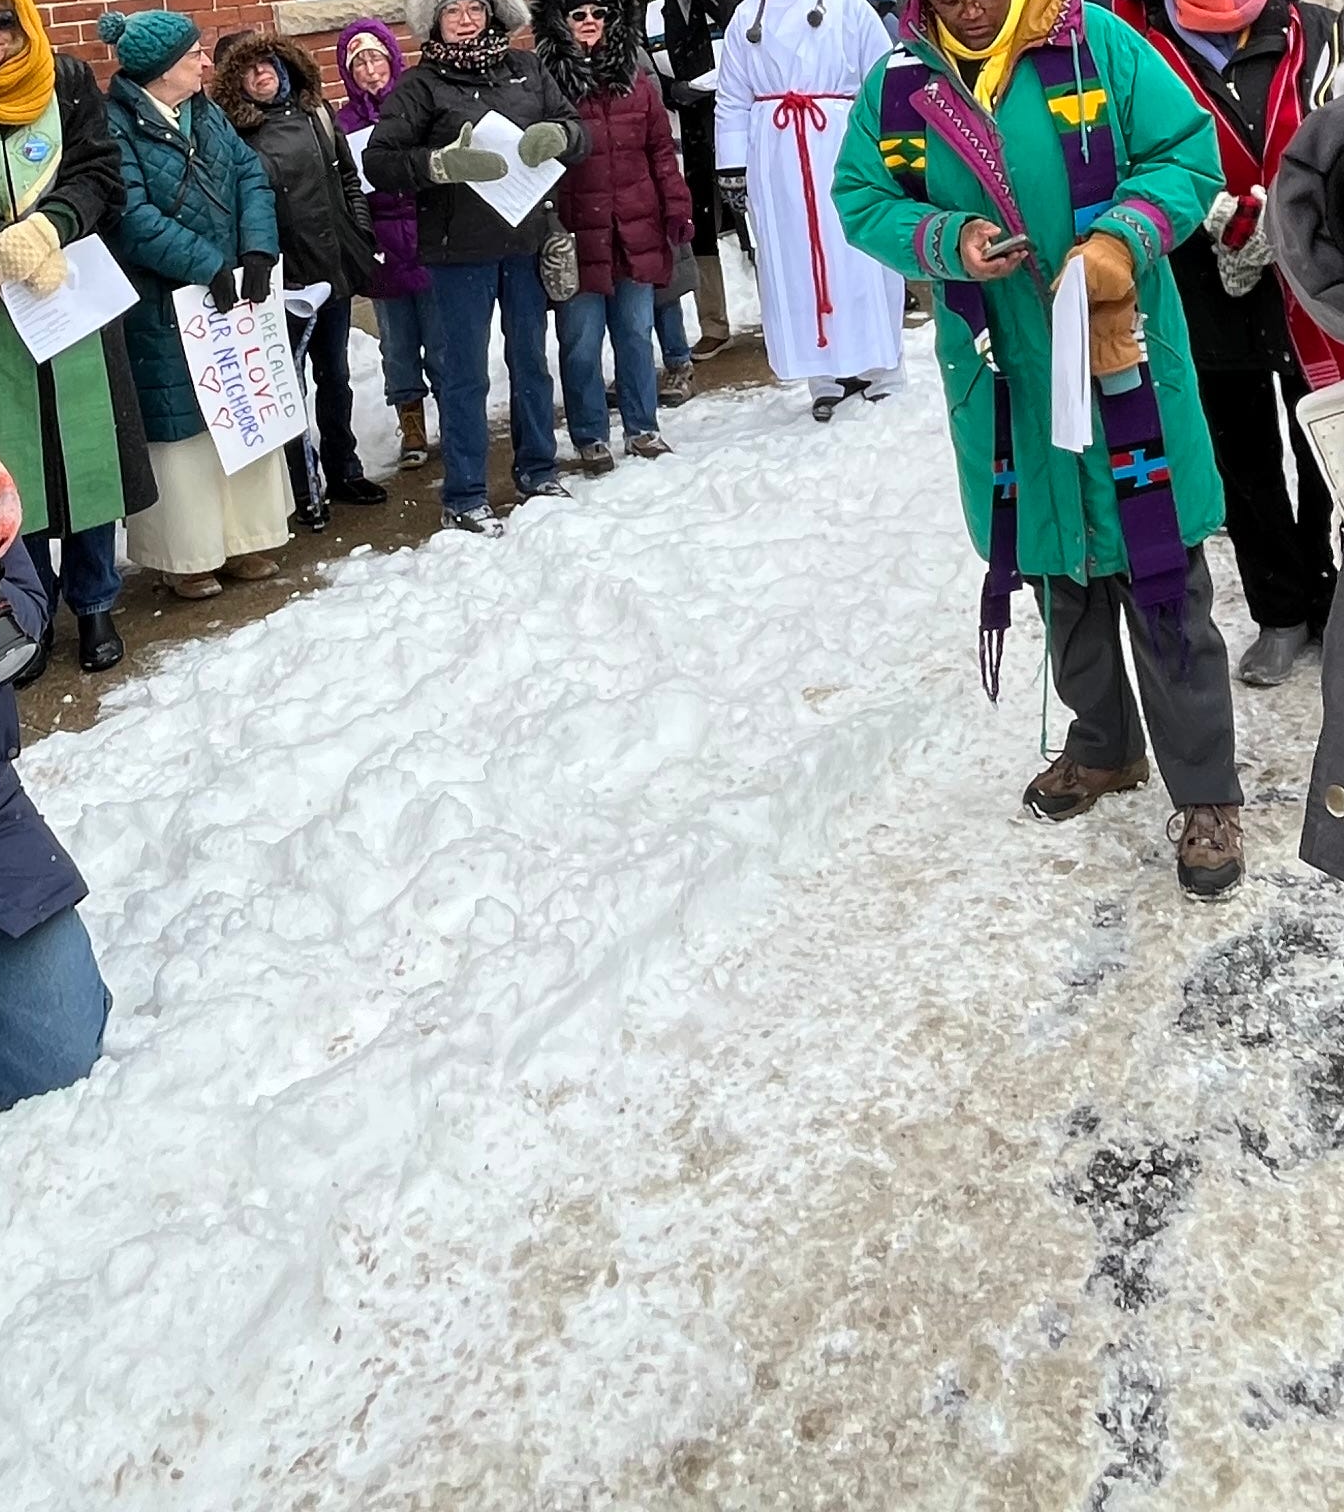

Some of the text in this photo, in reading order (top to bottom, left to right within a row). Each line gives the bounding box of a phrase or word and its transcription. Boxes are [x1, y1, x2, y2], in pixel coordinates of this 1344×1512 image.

[213, 347, 265, 448] NEIGHBORS
[233, 298, 279, 424] TO LOVE
[266, 343, 296, 418] CALLED
